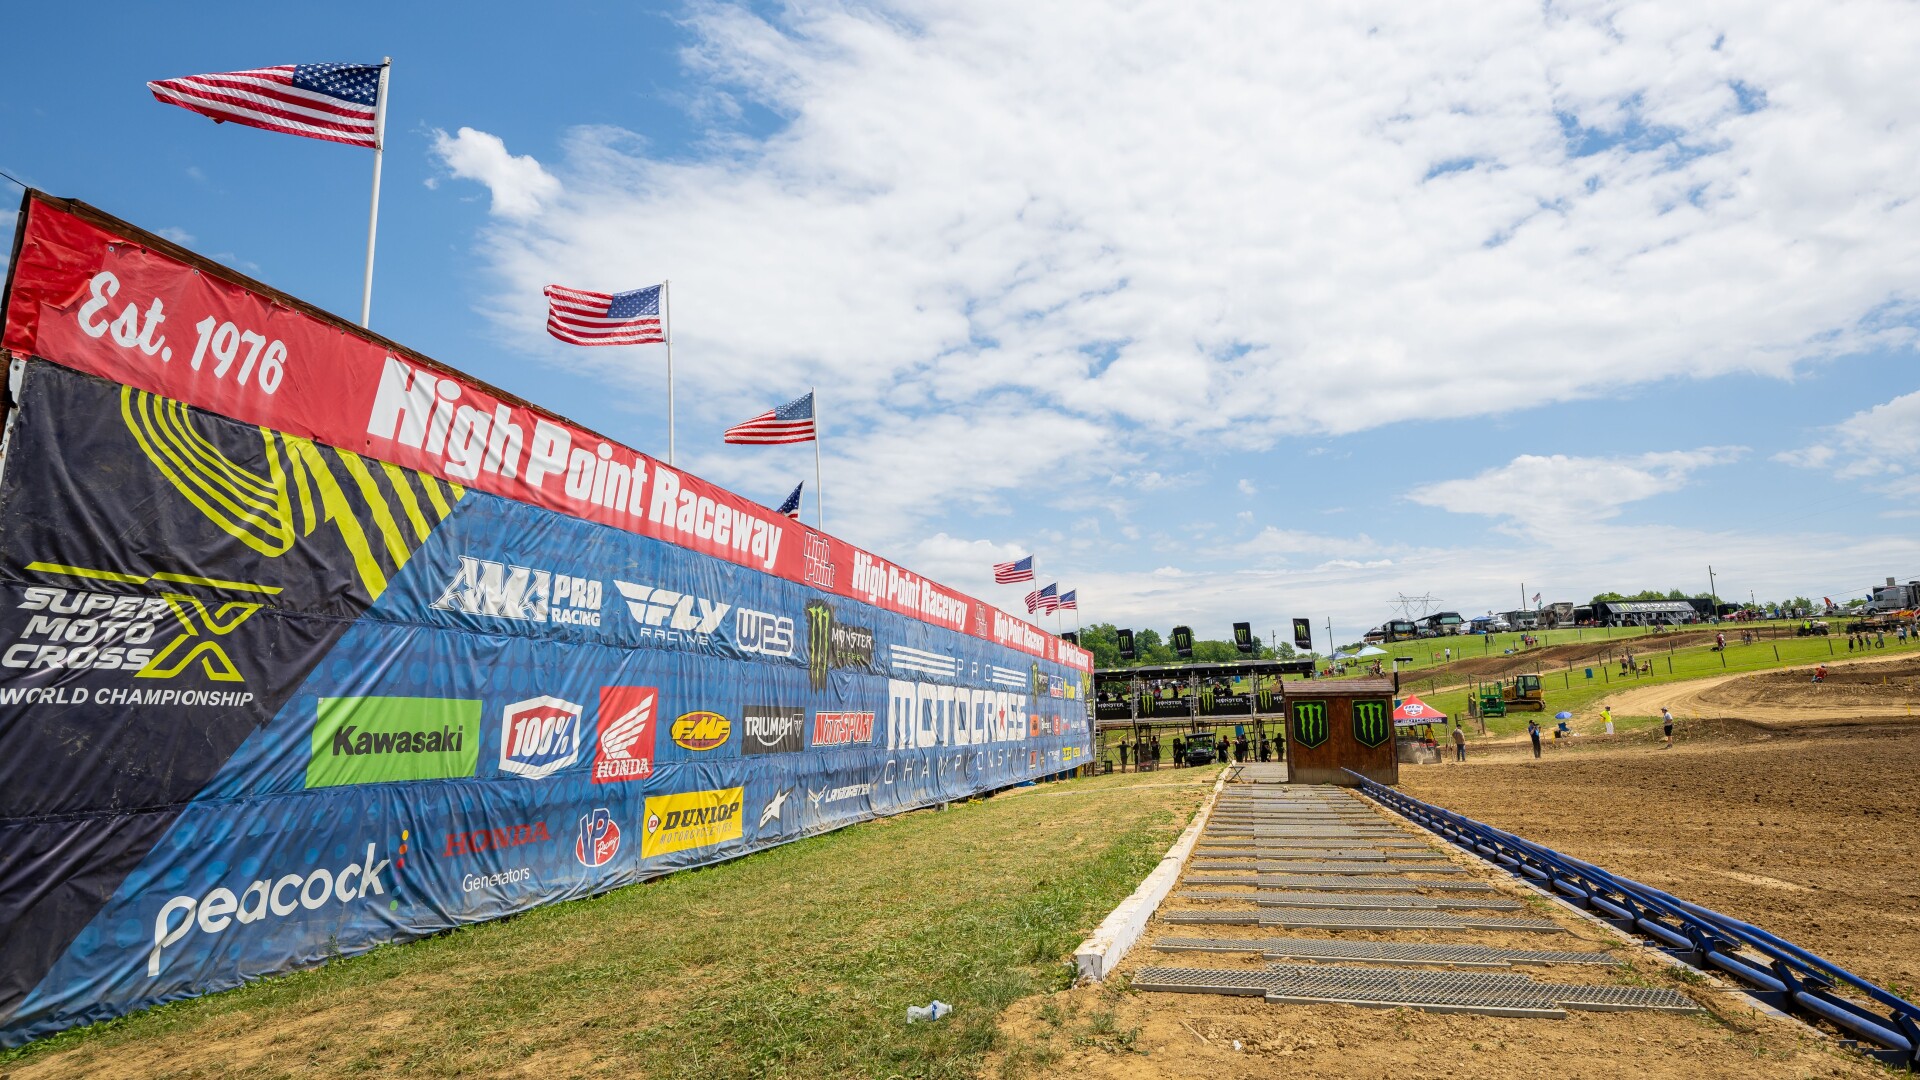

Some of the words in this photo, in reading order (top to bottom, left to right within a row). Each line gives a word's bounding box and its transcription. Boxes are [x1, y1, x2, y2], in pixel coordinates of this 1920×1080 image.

[78, 271, 172, 362] Est.
[191, 315, 287, 394] 1976
[367, 356, 523, 480] High
[526, 418, 647, 518] Point
[648, 465, 783, 570] Raceway
[803, 531, 830, 566] High
[428, 555, 551, 622] AMA
[804, 557, 835, 588] Point
[17, 587, 169, 620] SUPER
[552, 574, 602, 610] PRO
[613, 579, 732, 634] FLY
[852, 551, 887, 602] High
[887, 566, 921, 609] Point
[921, 580, 968, 630] Raceway
[20, 615, 155, 645] MOTO
[552, 607, 601, 627] RACING
[736, 607, 794, 657] WPS
[640, 627, 709, 646] RACING
[831, 626, 872, 650] MONSTER
[1, 643, 155, 670] CROSS
[0, 687, 88, 705] WORLD
[101, 687, 253, 707] CHAMPIONSHIP
[671, 715, 730, 740] FMF
[887, 678, 1027, 750] MOTOCROSS
[332, 724, 464, 756] Kawasaki
[513, 715, 573, 757] 100%
[745, 716, 793, 746] TRIUMPH
[596, 757, 650, 778] HONDA
[663, 802, 740, 831] DUNLOP
[442, 821, 551, 857] HONDA
[580, 808, 611, 866] VP
[598, 836, 620, 859] Racing
[660, 825, 714, 844] MOTORCYCLE
[462, 865, 531, 892] Generators
[147, 842, 391, 977] peacock
